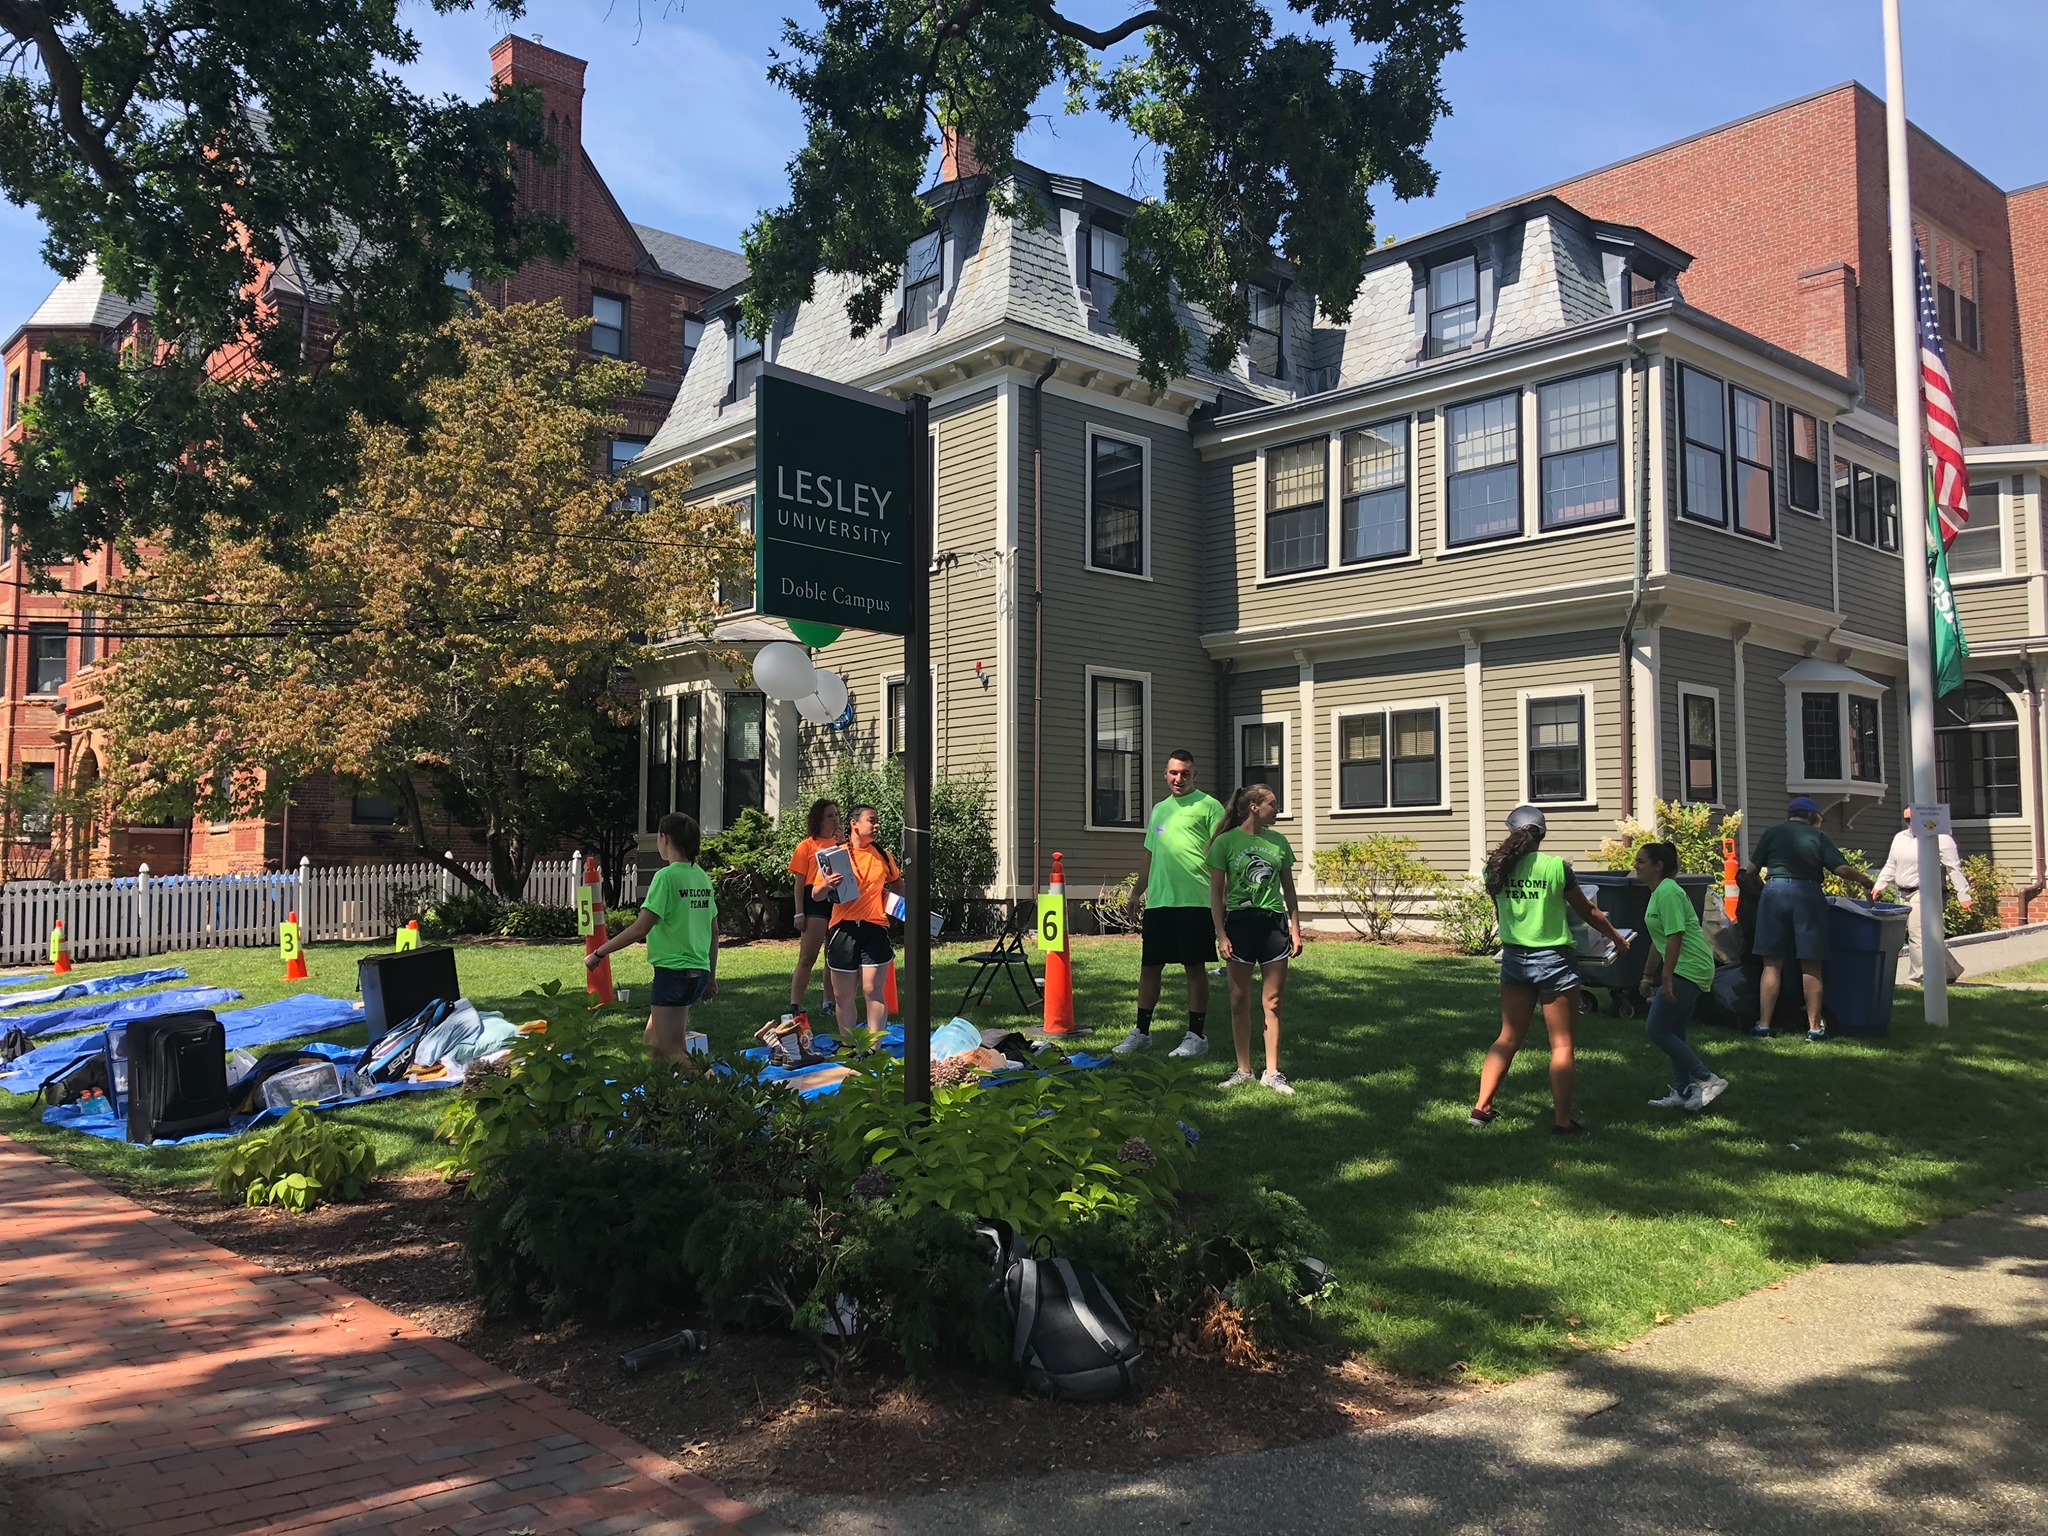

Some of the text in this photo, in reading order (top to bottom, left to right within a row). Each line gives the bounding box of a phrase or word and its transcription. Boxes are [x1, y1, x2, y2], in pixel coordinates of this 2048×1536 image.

[777, 465, 893, 520] LESLEY
[777, 509, 891, 546] UNIVERSITY
[780, 577, 891, 614] Doble Campus
[690, 900, 709, 908] TEAM
[1505, 890, 1539, 899] TEAM
[581, 900, 590, 926] 5
[1042, 910, 1058, 941] 6
[283, 932, 294, 953] 3
